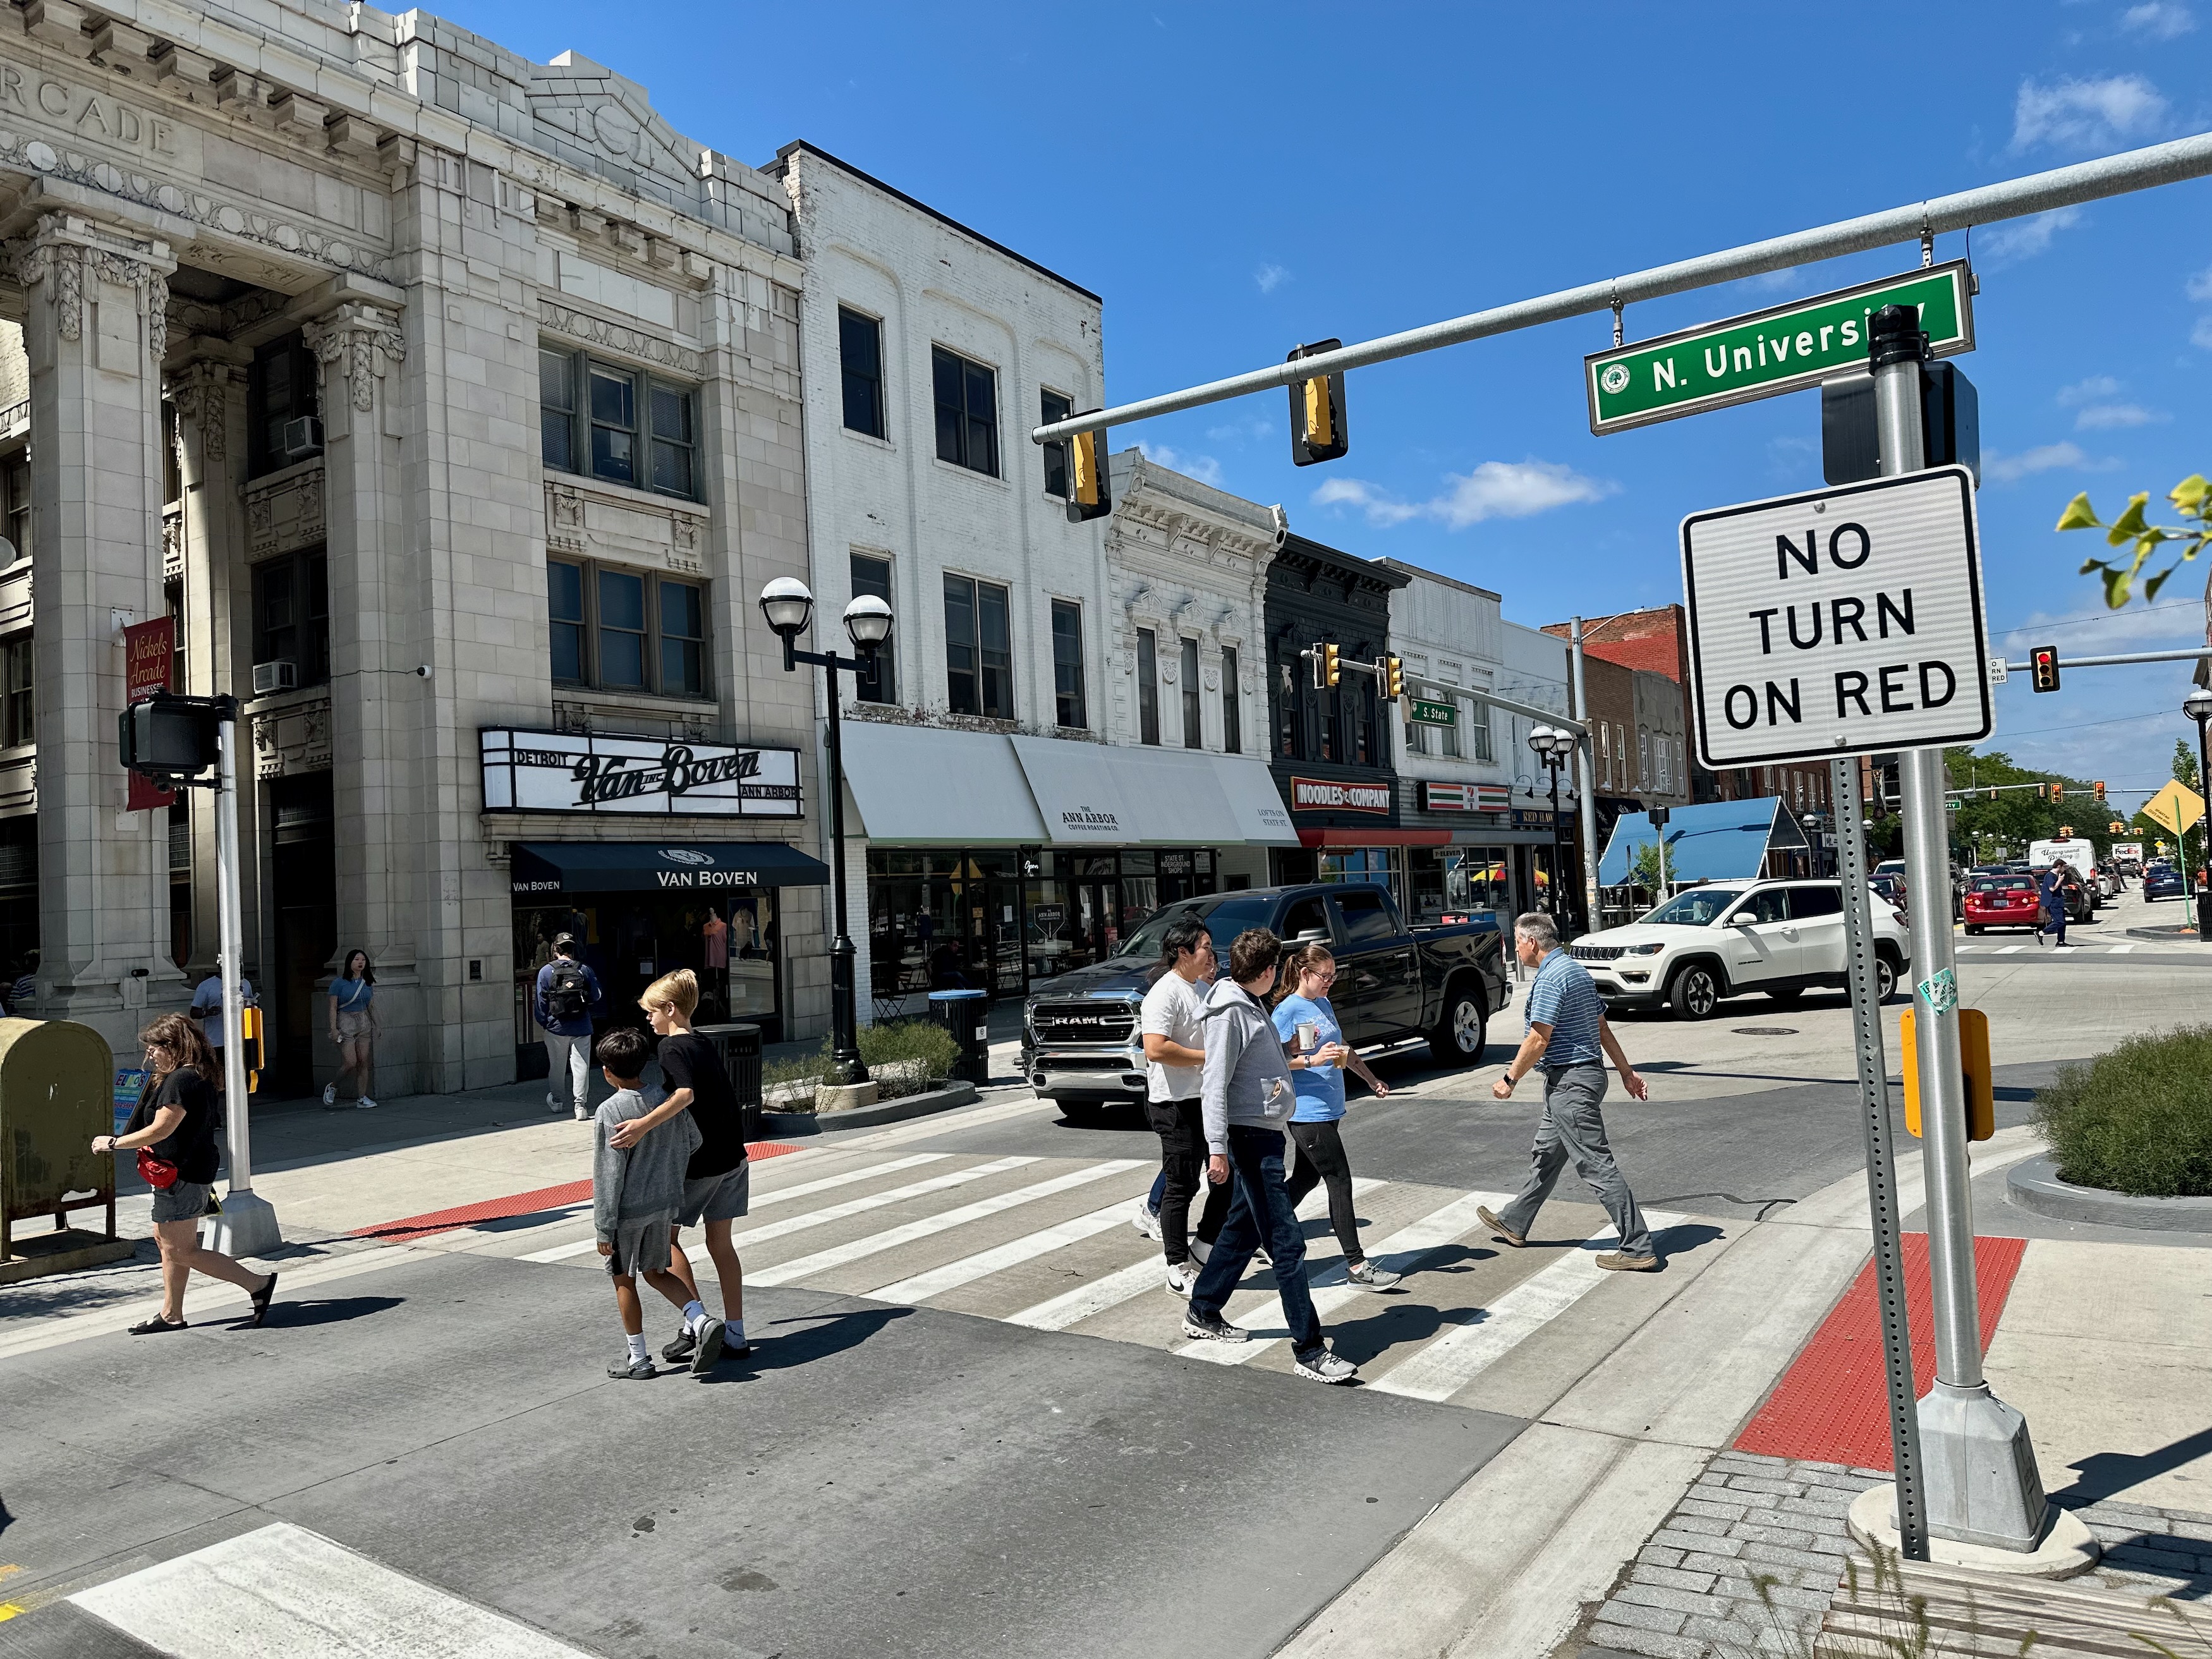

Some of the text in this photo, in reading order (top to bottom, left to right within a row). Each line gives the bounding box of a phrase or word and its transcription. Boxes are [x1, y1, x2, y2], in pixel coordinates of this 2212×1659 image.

[0, 64, 174, 156] RCADE
[1653, 357, 1687, 392] N.
[1705, 302, 1926, 379] Universi
[1776, 522, 1871, 580] NO
[1749, 588, 1916, 655] TURN
[130, 632, 167, 662] Nickels
[130, 657, 166, 686] Arcade
[1724, 660, 1957, 730] ON RED
[1423, 707, 1448, 720] S. State
[518, 751, 568, 767] DETROIT
[573, 755, 646, 802] Van
[657, 746, 760, 794] Boven
[741, 786, 796, 798] ANN ARBOR
[1297, 784, 1390, 808] NOODLES & COMPANY
[1062, 812, 1119, 825] ANN ARBOR
[1523, 811, 1537, 822] RED
[1539, 812, 1554, 822] HAW
[1024, 860, 1040, 873] Open
[2048, 854, 2073, 863] Printing
[513, 881, 560, 892] VAN BOVEN
[657, 871, 758, 887] VAN BOVEN
[1055, 1016, 1098, 1024] RAM
